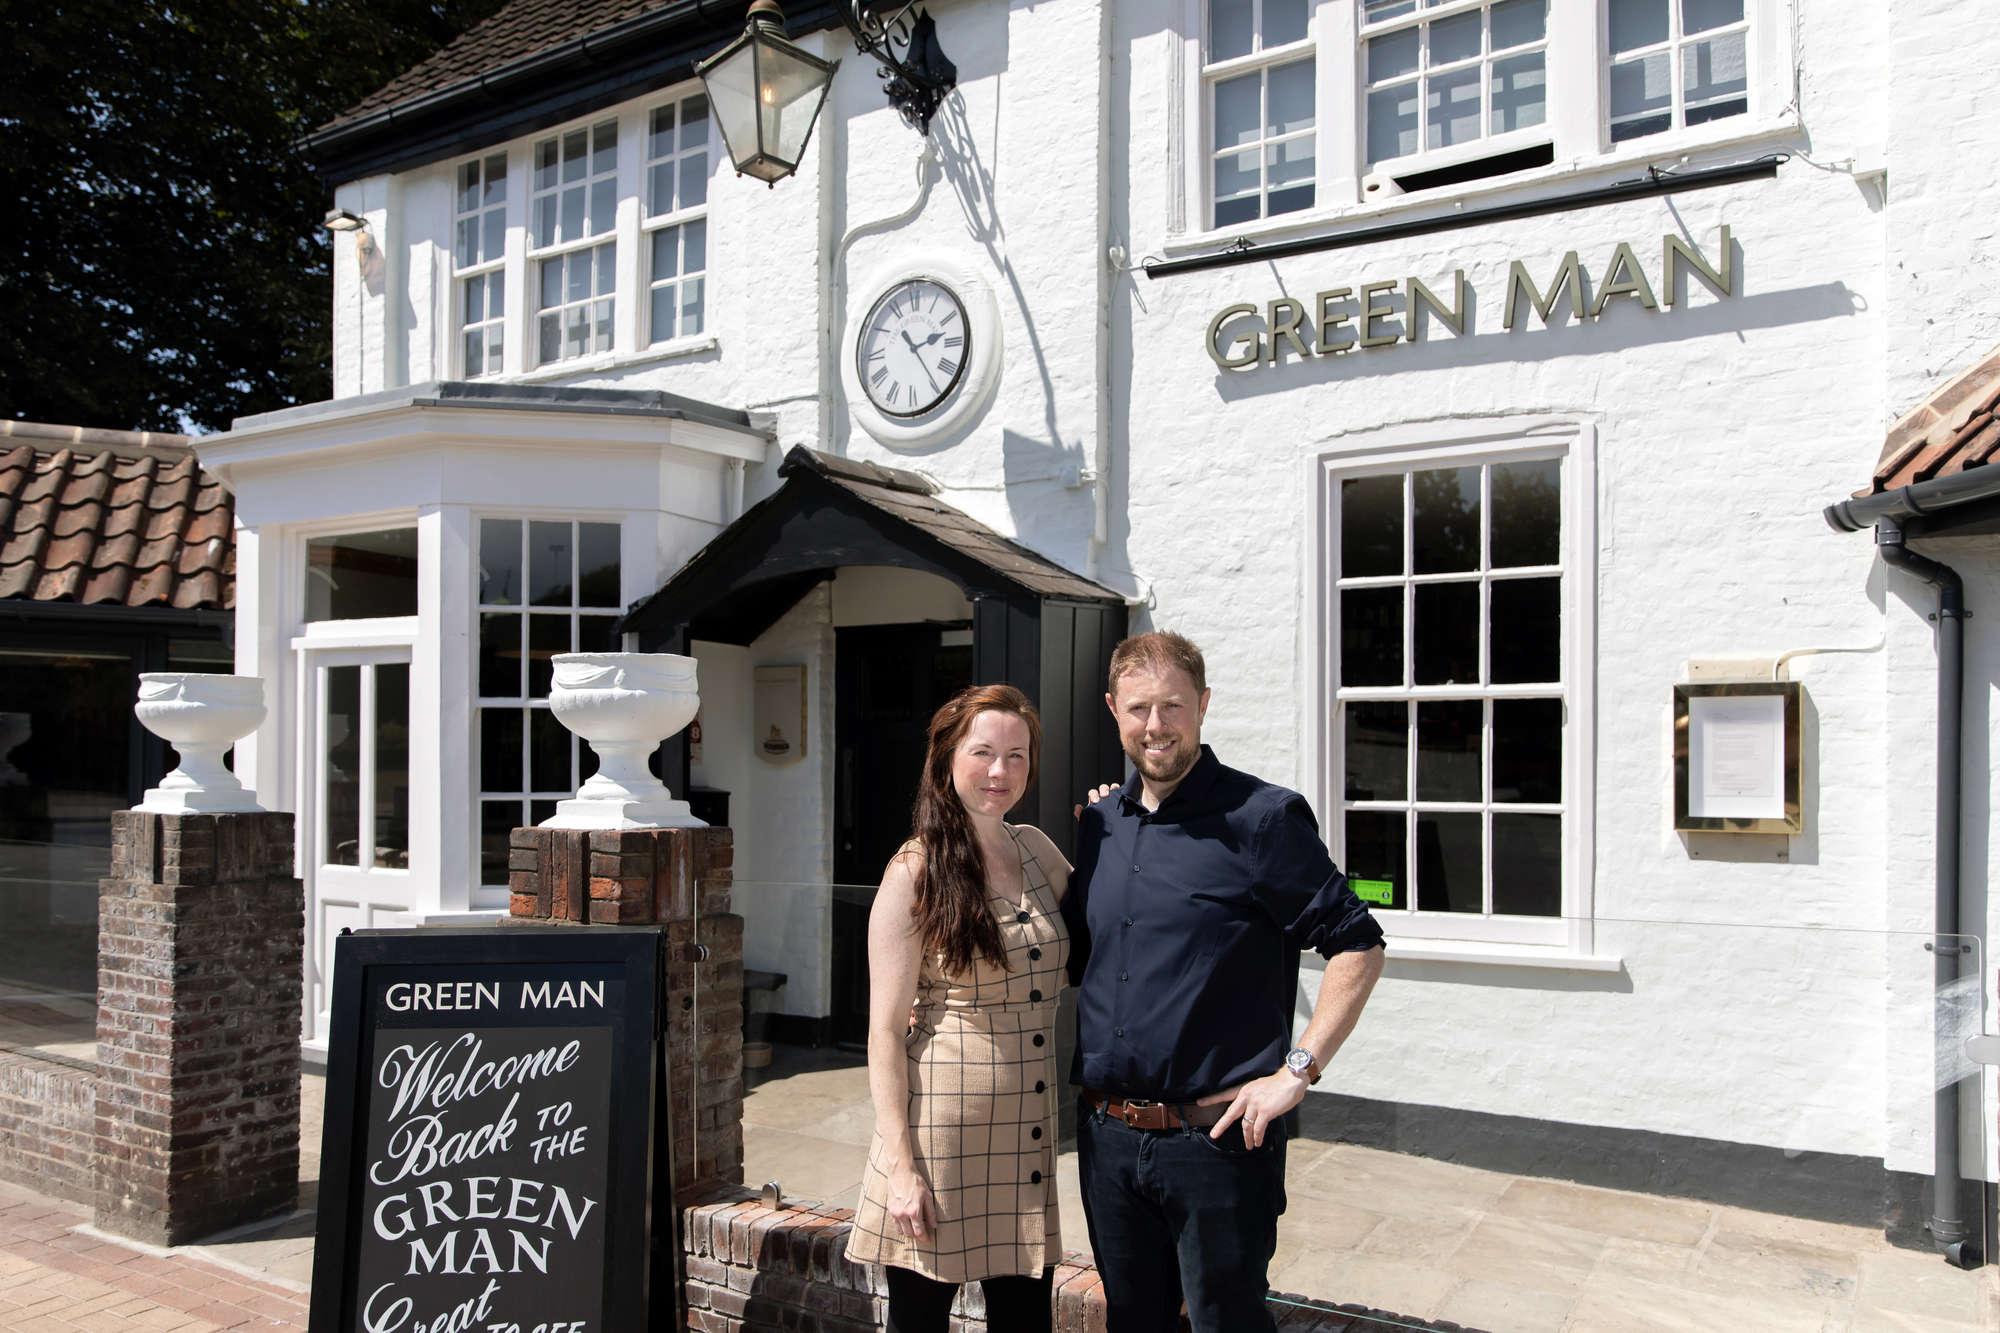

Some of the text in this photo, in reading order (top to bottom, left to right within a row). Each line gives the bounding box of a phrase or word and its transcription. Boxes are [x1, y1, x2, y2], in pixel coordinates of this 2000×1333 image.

[1206, 224, 1731, 369] GREEN MAN
[386, 980, 605, 1011] GREEN MAN
[379, 1032, 580, 1122] Welcome
[370, 1092, 520, 1185] Back
[537, 1101, 572, 1131] TO
[530, 1126, 588, 1164] THE
[374, 1176, 598, 1241] GREEN
[405, 1229, 553, 1276] MAN
